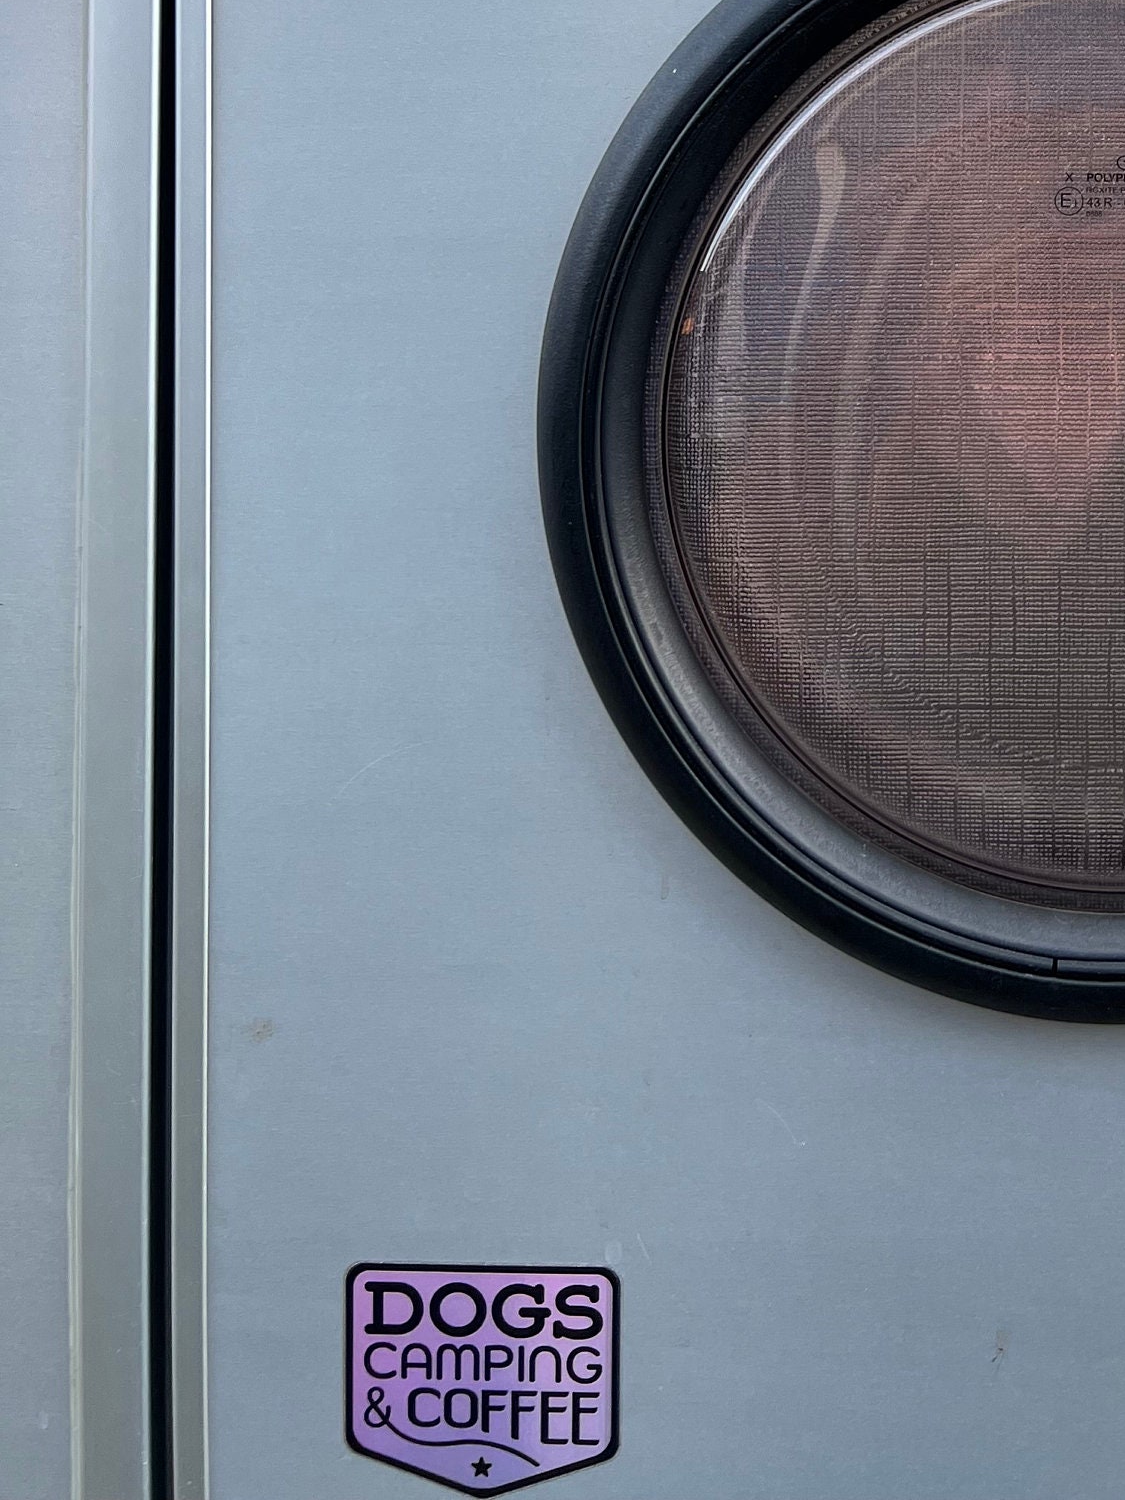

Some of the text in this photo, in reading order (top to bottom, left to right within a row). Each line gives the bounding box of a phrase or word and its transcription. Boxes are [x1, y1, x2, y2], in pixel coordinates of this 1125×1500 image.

[364, 1281, 604, 1340] DOGS
[363, 1342, 603, 1384] CAMPING
[363, 1386, 601, 1446] & COFFEE
